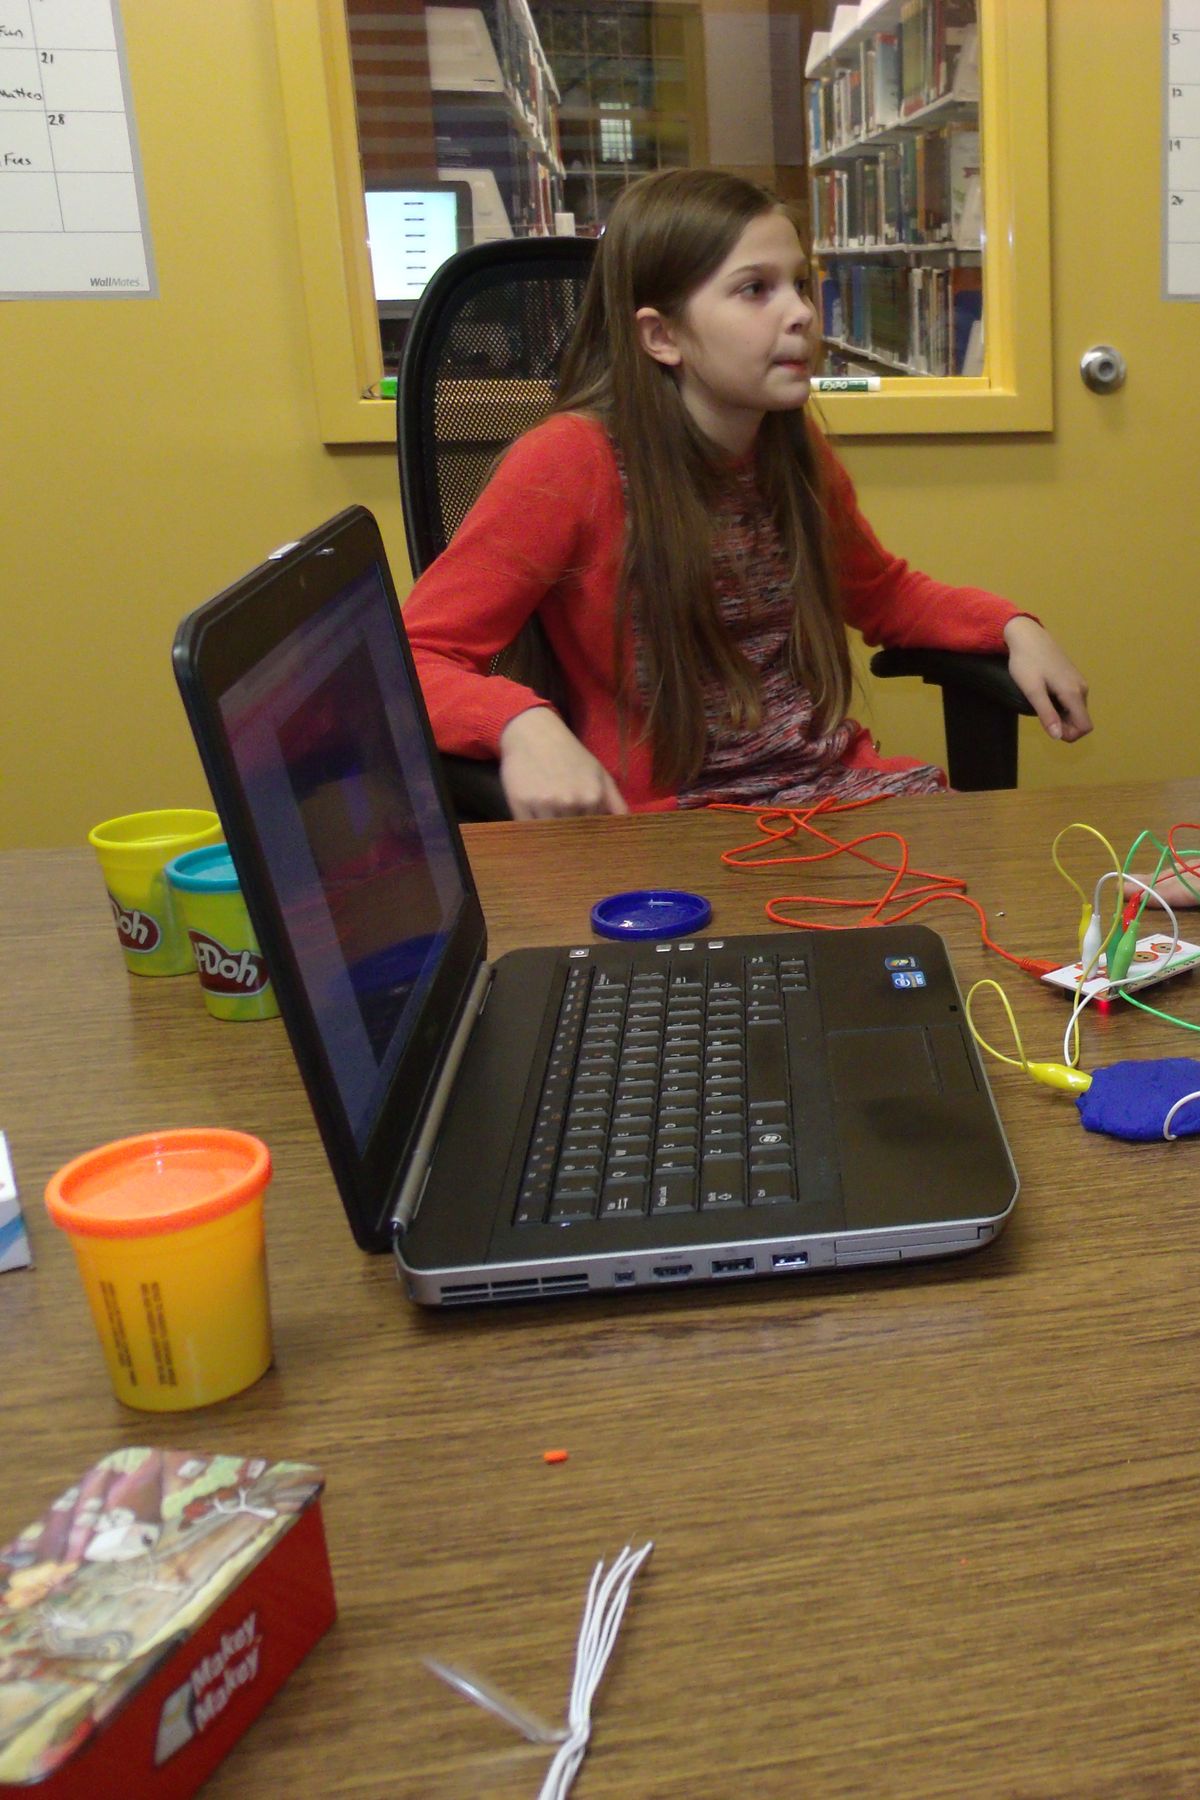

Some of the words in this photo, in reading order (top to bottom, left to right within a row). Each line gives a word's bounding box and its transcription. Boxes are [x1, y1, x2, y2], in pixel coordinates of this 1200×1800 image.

[1170, 33, 1181, 46] 5
[41, 52, 54, 63] 21
[1172, 88, 1183, 98] 12
[48, 114, 65, 126] 28
[1168, 140, 1181, 151] 19
[89, 277, 140, 287] WallMates
